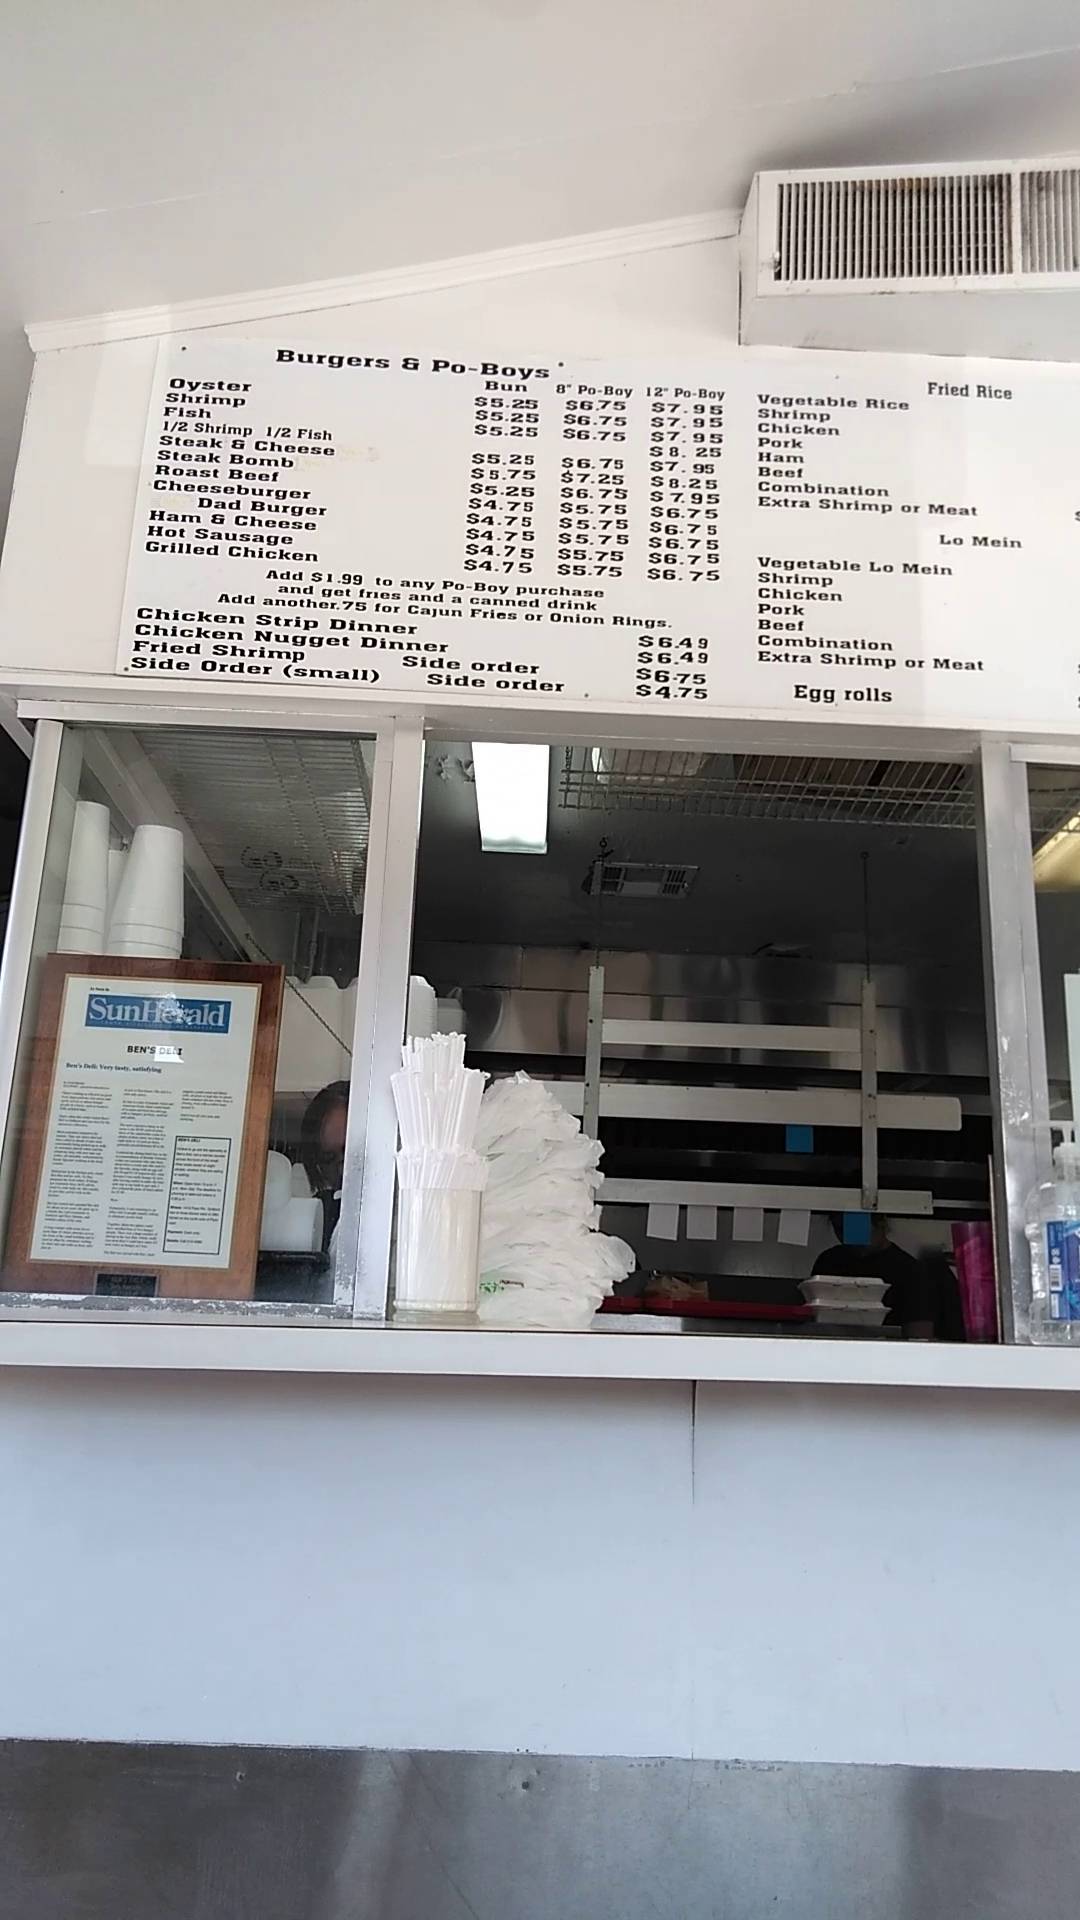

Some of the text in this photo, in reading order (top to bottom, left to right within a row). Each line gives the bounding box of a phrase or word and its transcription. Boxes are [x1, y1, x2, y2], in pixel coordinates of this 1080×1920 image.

[276, 349, 550, 381] Burgers & Po-Boys
[169, 378, 723, 416] Oyster $5.25 $6.75 $7.95
[485, 380, 725, 402] Bun 8" Po-Boy 12" Po-Boy
[928, 382, 1012, 400] Fried Rice
[165, 392, 723, 429] Shrimp $5.25 $6.75 $7.95
[757, 394, 909, 410] Vegetable Rice
[163, 406, 724, 444] Fish $5.25 $6.75 $7.95
[758, 408, 831, 423] Shrimp
[163, 420, 188, 433] 1/2
[194, 422, 253, 438] Shrimp
[266, 426, 292, 439] 1/2
[297, 428, 332, 441] Fish
[758, 422, 840, 436] Chicken
[758, 437, 803, 449] Pork
[159, 435, 715, 474] Steak & Cheese $5.25 $6.75 $7.95
[758, 451, 804, 464] Ham
[157, 450, 718, 490] Steak Bomb $5.75 $7.25 $8.25
[758, 466, 803, 478] Beef
[154, 464, 720, 505] Roast Beef $5.25 $6.75 $7.95
[758, 481, 889, 497] Combination
[153, 479, 718, 520] Cheeseburger $4.75 $5.75 $6.75
[758, 496, 977, 516] Extra Shrimp or Meat
[197, 497, 717, 536] Dad Burger $4.75 $5.75 $6.75
[149, 510, 719, 550] Ham & Cheese $4.75 $5.75 $6.75
[147, 525, 720, 565] Hot Sausage $4.75 $5.75 $6.75
[940, 534, 1022, 548] Lo Mein
[145, 541, 720, 582] Grilled Chicken $4.75 $5.75 $6.75
[757, 556, 952, 576] Vegetable Lo Mein
[266, 570, 604, 598] Add $1.99 to any Po-Boy purchase
[758, 572, 833, 588] Shrimp
[278, 585, 597, 611] and get fries and a canned drink
[758, 587, 842, 602] Chicken
[217, 593, 255, 605] Add
[374, 602, 400, 614] for
[407, 604, 462, 618] Cajun
[470, 608, 517, 620] Fries
[524, 613, 543, 622] or
[550, 612, 604, 625] Onion
[612, 616, 672, 629] Rings.
[758, 603, 804, 616] Pork
[137, 607, 708, 650] Chicken Strip Dinner $6.49
[758, 618, 804, 632] Beef
[135, 624, 708, 665] Chicken Nugget Dinner $6.49
[758, 634, 893, 651] Combination
[132, 640, 706, 685] Fried Shrimp Side order $6.75
[758, 650, 984, 671] Extra Shrimp or Meat
[130, 656, 708, 700] Side Order (small) Side order $4.75
[794, 684, 892, 704] Egg rolls
[127, 1045, 156, 1054] BEN'S
[66, 1061, 162, 1074] Ben's Deli: Very tasty, satisfying
